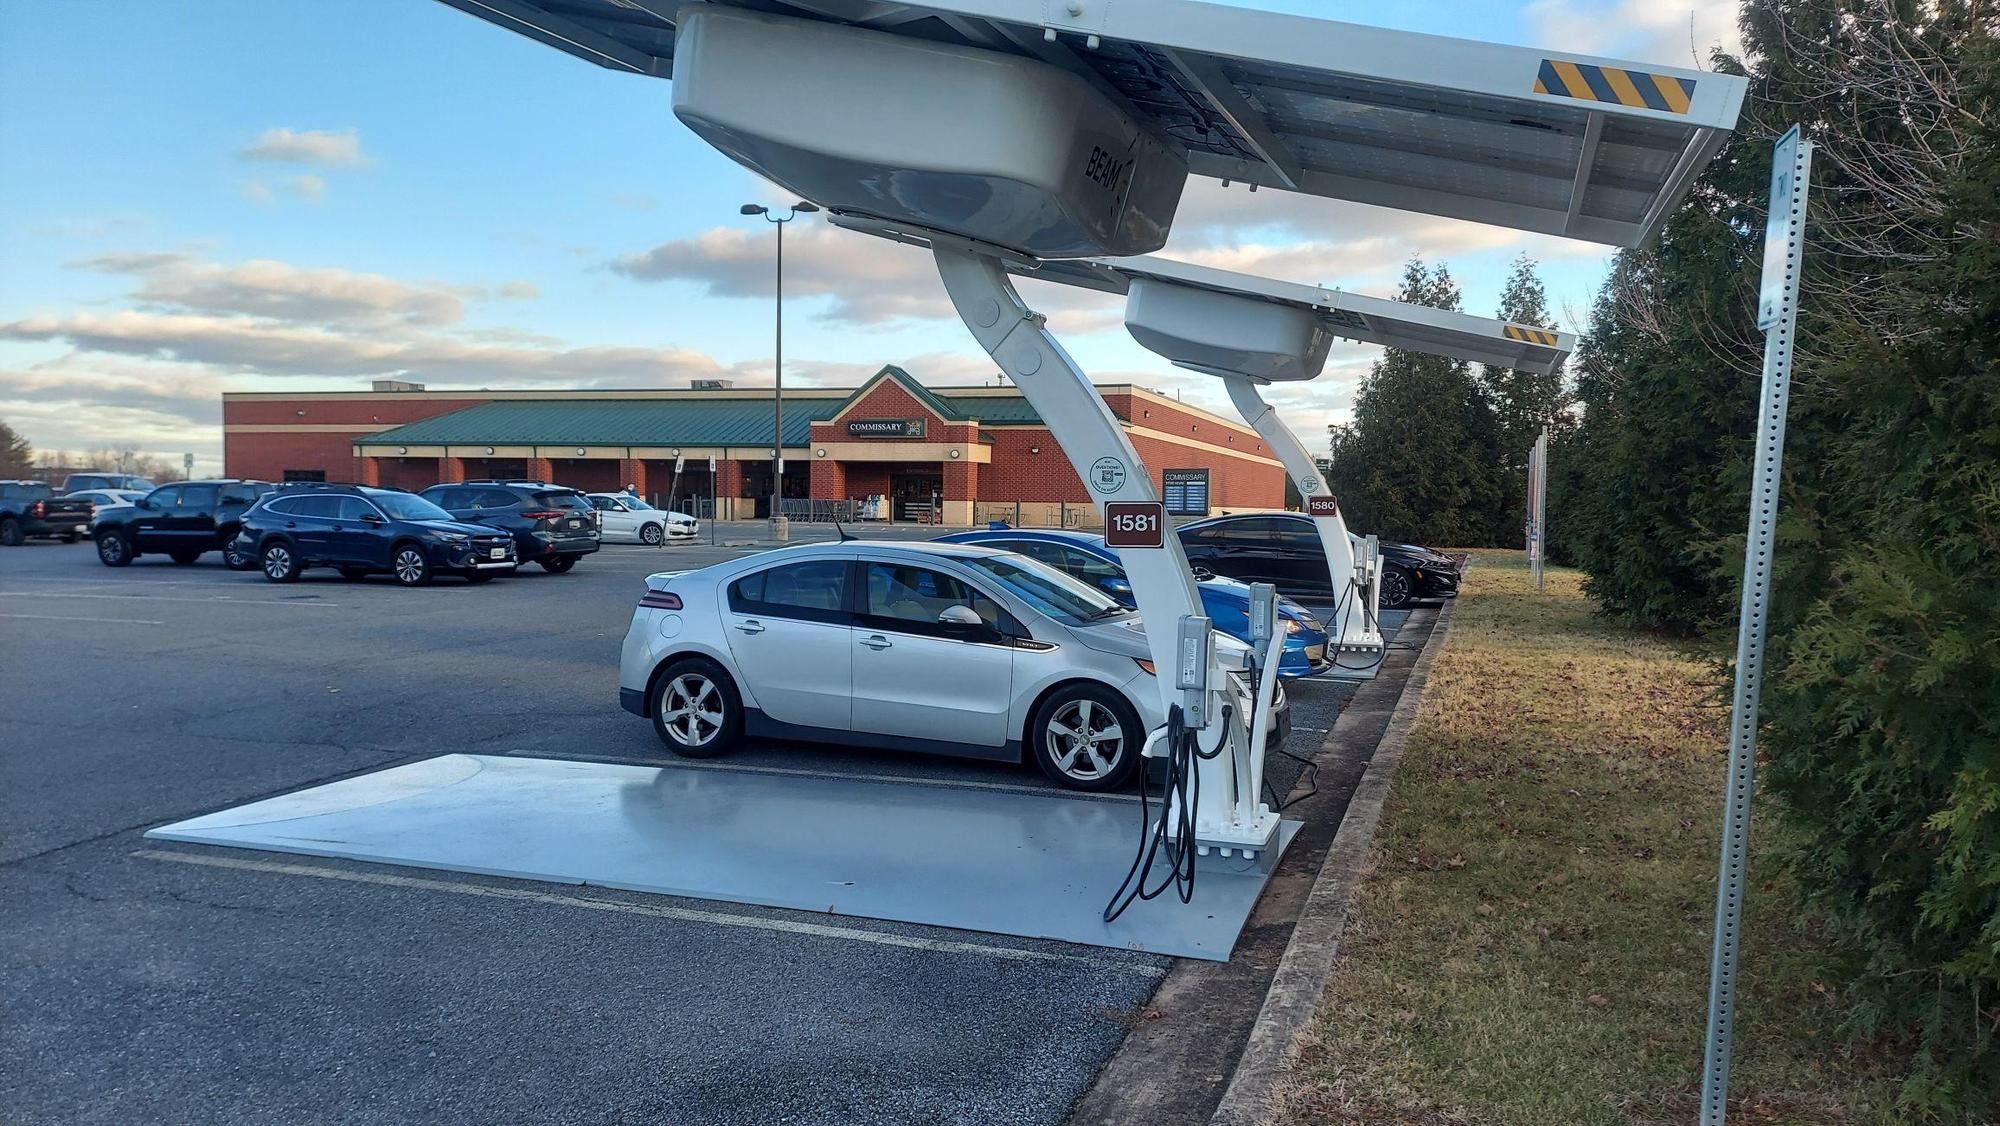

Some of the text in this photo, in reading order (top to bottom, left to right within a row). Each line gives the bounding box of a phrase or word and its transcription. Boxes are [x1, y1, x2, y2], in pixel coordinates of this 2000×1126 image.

[1085, 145, 1123, 192] BEAM
[849, 423, 902, 431] COMMISSARY
[1165, 473, 1206, 481] COMMISSARY
[1310, 501, 1335, 510] 1580
[1112, 514, 1157, 532] 1581
